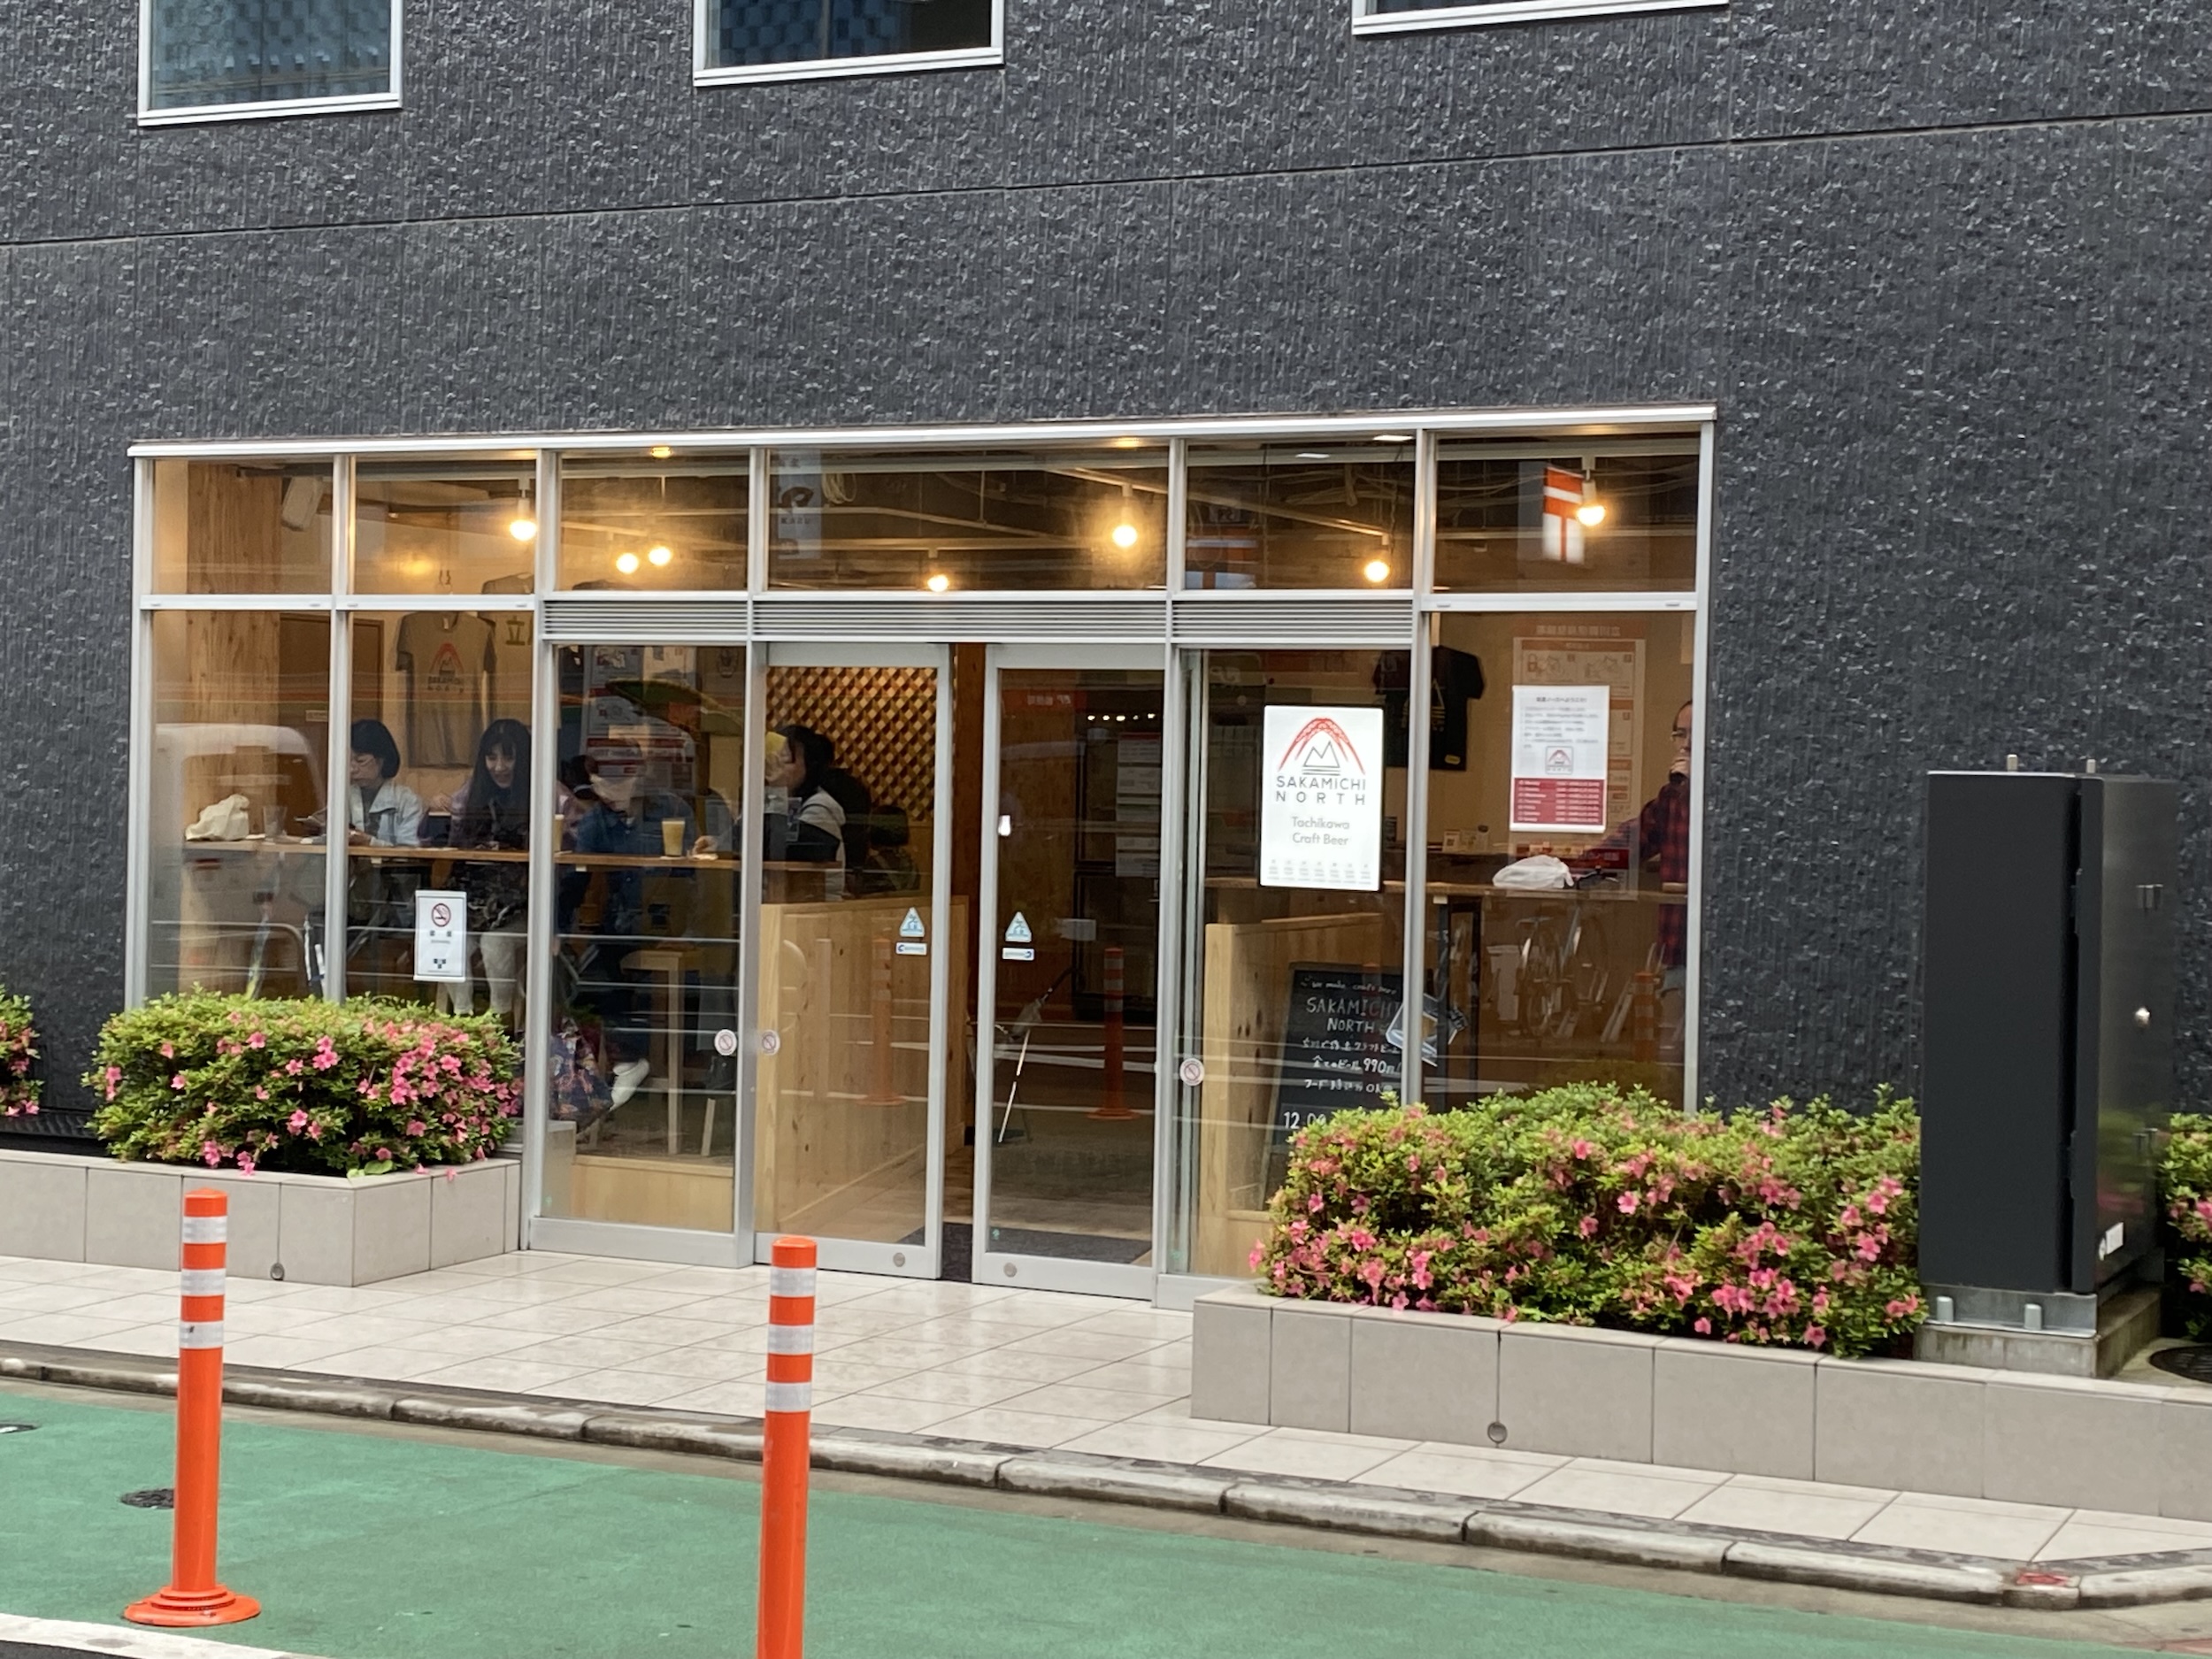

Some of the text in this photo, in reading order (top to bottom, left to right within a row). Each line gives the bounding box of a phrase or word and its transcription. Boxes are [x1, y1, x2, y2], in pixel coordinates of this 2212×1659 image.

[1276, 775, 1366, 790] SAKAMICHI
[1275, 791, 1366, 805] NORTH
[1291, 816, 1350, 830] Tachikawa
[1292, 833, 1348, 846] Craft Beer
[1327, 1018, 1375, 1033] NORTH
